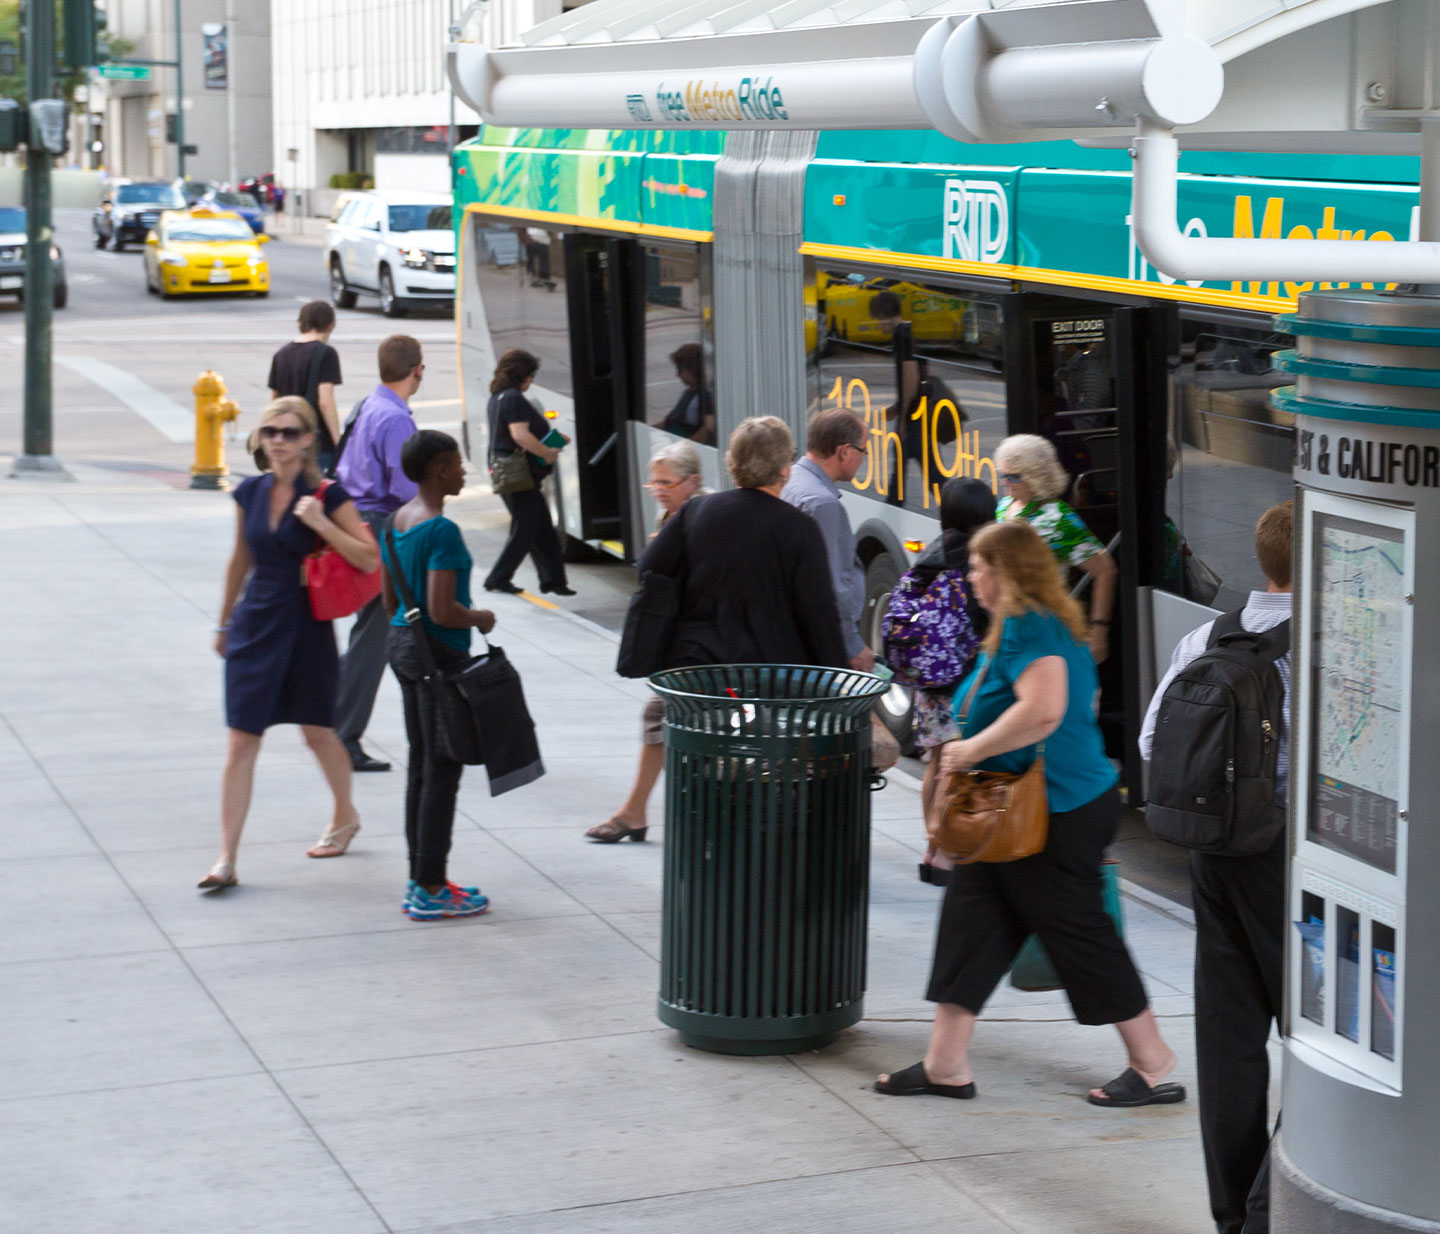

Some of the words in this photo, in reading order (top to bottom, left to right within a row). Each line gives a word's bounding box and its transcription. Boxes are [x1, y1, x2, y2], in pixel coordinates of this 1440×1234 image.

[656, 82, 691, 122] free
[942, 178, 1009, 264] RTD
[1051, 321, 1074, 333] EXIT
[1074, 319, 1105, 331] DOOR
[1317, 433, 1331, 476] &
